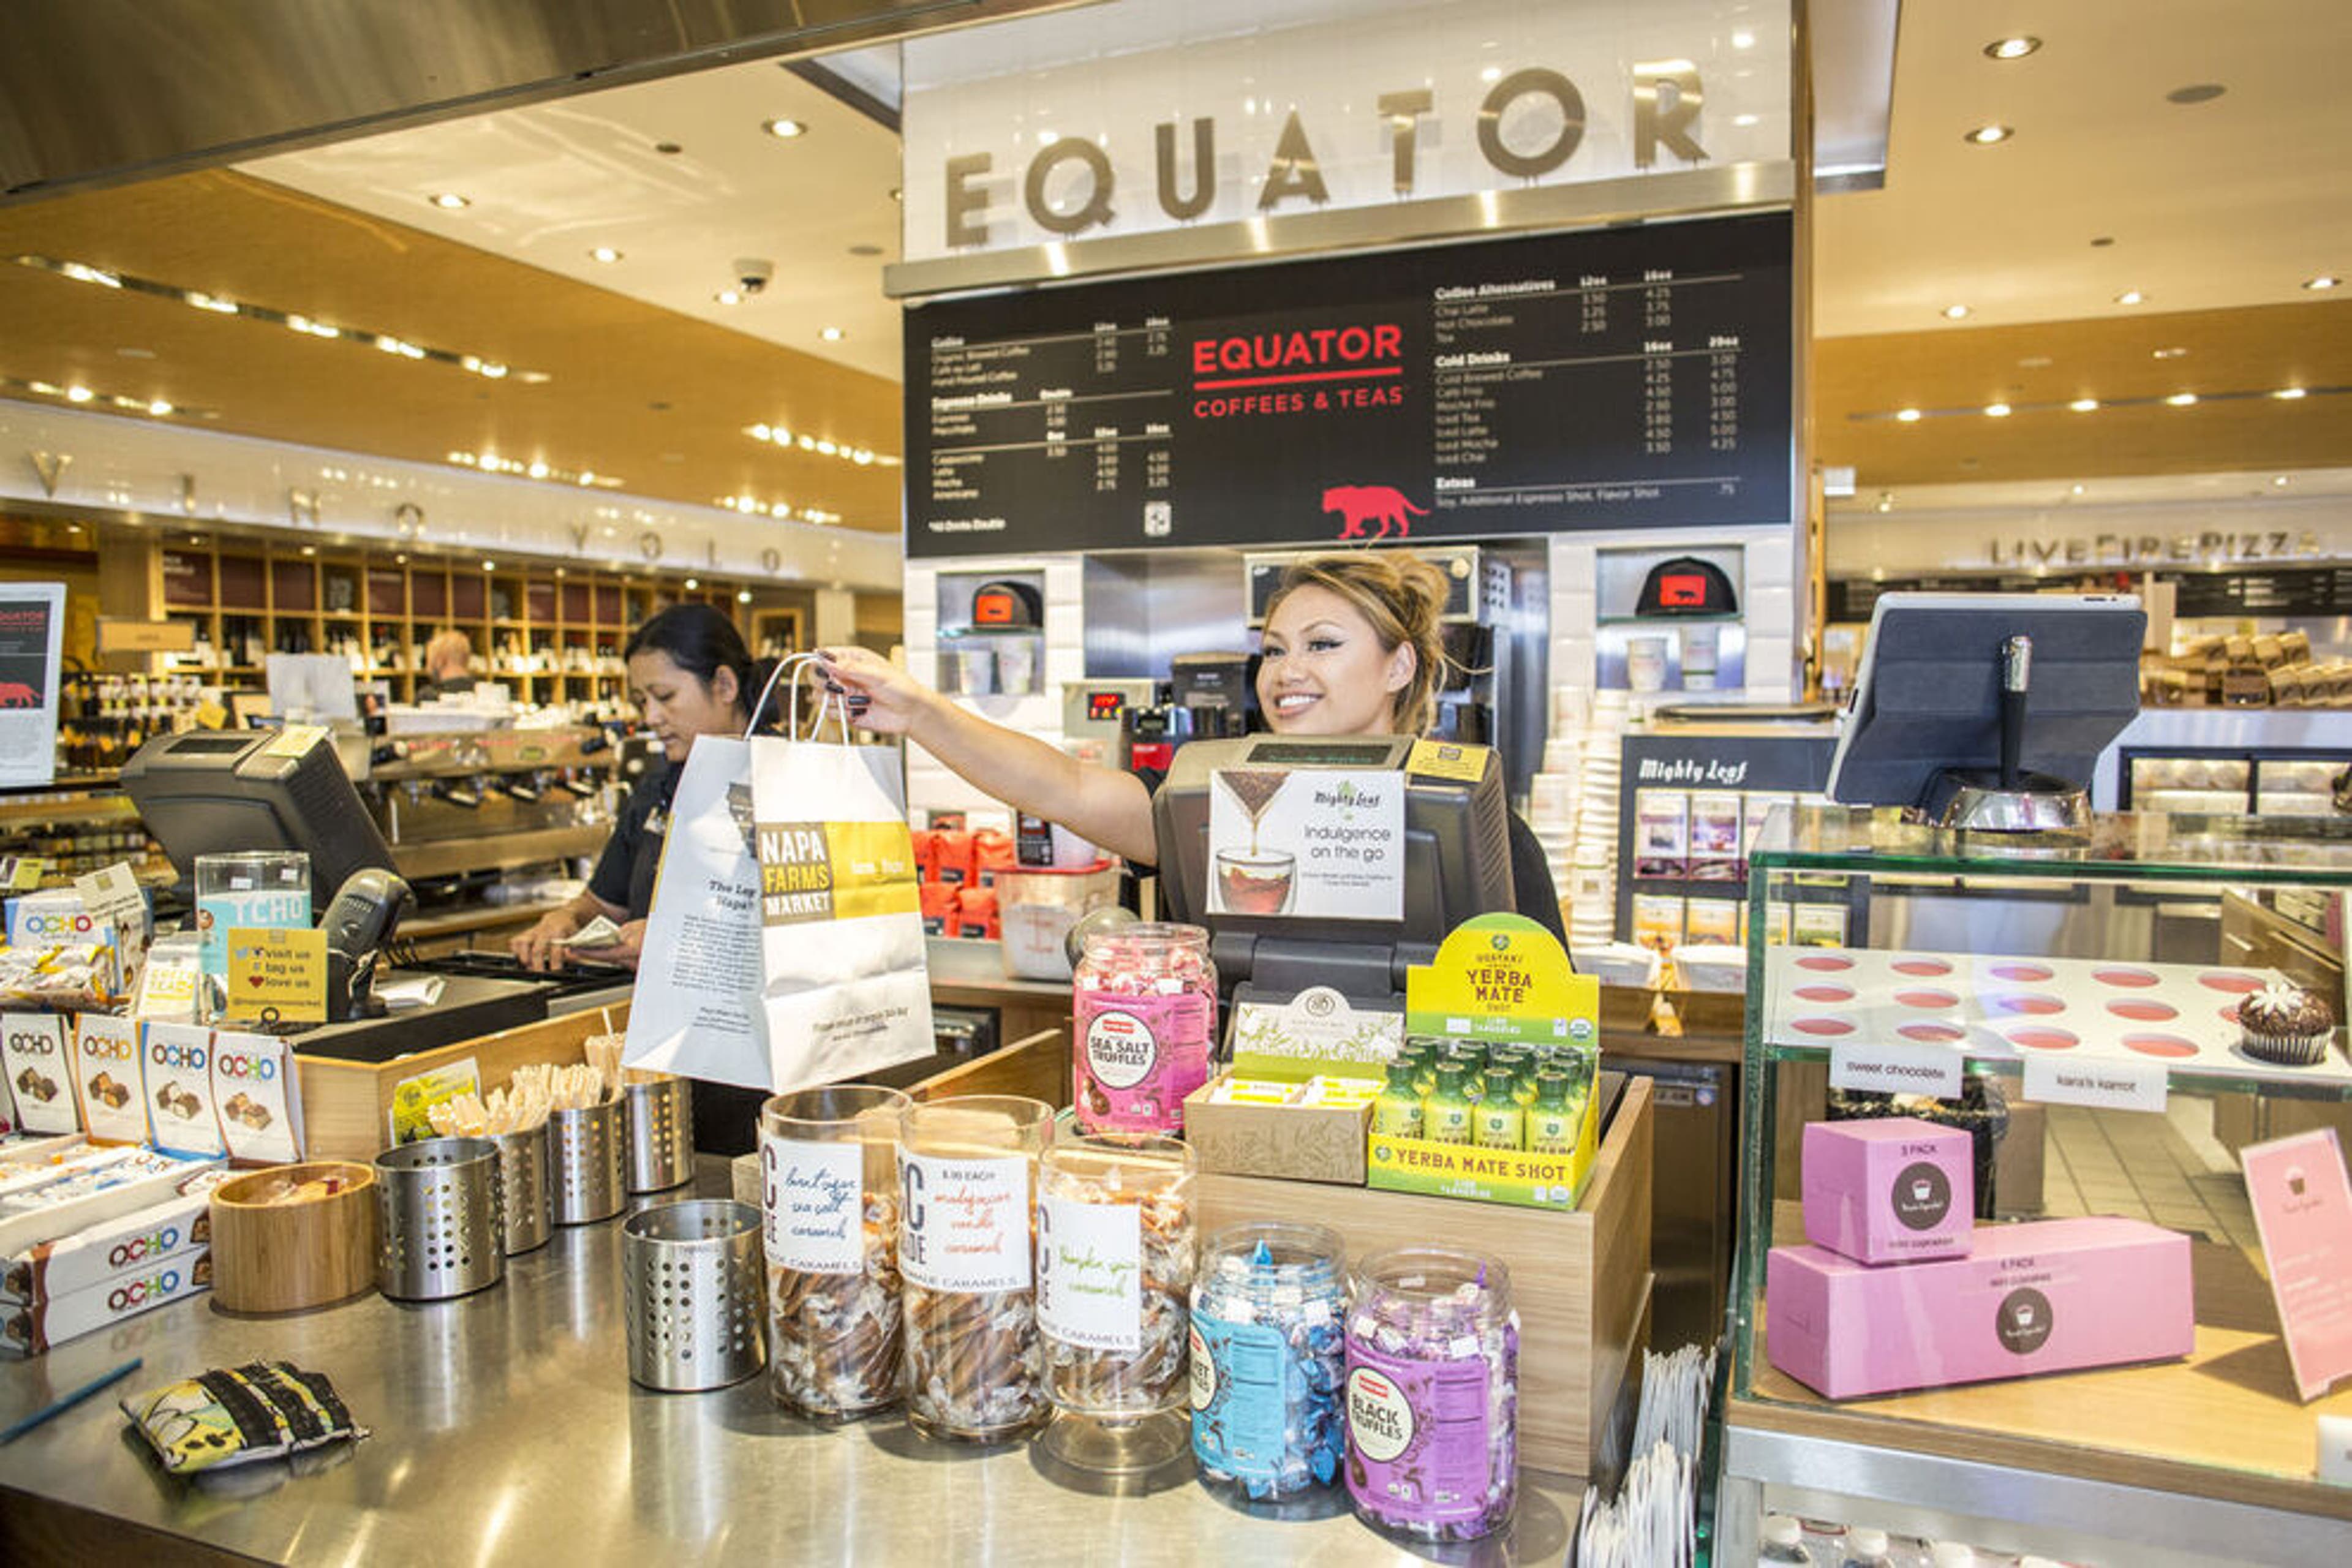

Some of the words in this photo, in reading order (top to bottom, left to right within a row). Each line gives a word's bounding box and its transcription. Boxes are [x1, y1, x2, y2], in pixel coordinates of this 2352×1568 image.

[945, 58, 1711, 247] EQUATOR
[1434, 287, 1476, 300] Coffee
[1478, 280, 1556, 296] Alternatives
[1193, 324, 1403, 374] EQUATOR
[1434, 354, 1464, 368] Cold
[1467, 352, 1511, 365] Drinks
[1194, 392, 1305, 418] COFFEES
[1313, 391, 1329, 410] &
[1337, 386, 1404, 407] TEAS
[1638, 760, 1704, 783] Mighty
[1706, 760, 1749, 784] Leaf
[1315, 791, 1355, 807] Mighty
[1304, 824, 1391, 843] Indulgence
[762, 831, 826, 862] NAPA
[1311, 846, 1331, 858] on
[1334, 845, 1360, 858] the
[1363, 848, 1385, 863] go
[709, 880, 734, 893] The
[763, 864, 831, 894] FARMS
[232, 892, 304, 924] TCHO
[765, 894, 831, 916] MARKET
[26, 914, 91, 933] OCHO
[295, 951, 311, 959] us
[265, 962, 286, 974] tag
[1466, 968, 1532, 989] YERBA
[1476, 986, 1525, 1004] MATE
[10, 1033, 54, 1054] OCHO
[84, 1035, 132, 1060] OCHO
[1090, 1038, 1112, 1051] SEA
[1116, 1041, 1150, 1054] SALT
[153, 1044, 206, 1069] OCHO
[219, 1054, 274, 1079] OCHO
[1093, 1050, 1147, 1066] TRUFFLES
[1846, 1061, 1882, 1074] sweet
[1886, 1063, 1945, 1080] chocolate
[1910, 1144, 1937, 1155] PACK
[1396, 1149, 1455, 1170] YERBA
[1462, 1157, 1510, 1177] MATE
[1515, 1163, 1567, 1181] SHOT
[109, 1227, 178, 1268] OCHO
[2009, 1257, 2035, 1268] PACK
[108, 1269, 179, 1311] OCHO
[942, 1277, 1018, 1289] CARAMELS
[1061, 1325, 1134, 1344] CARAMELS
[1352, 1393, 1400, 1427] BLACK
[1351, 1408, 1403, 1440] TRUFFLES
